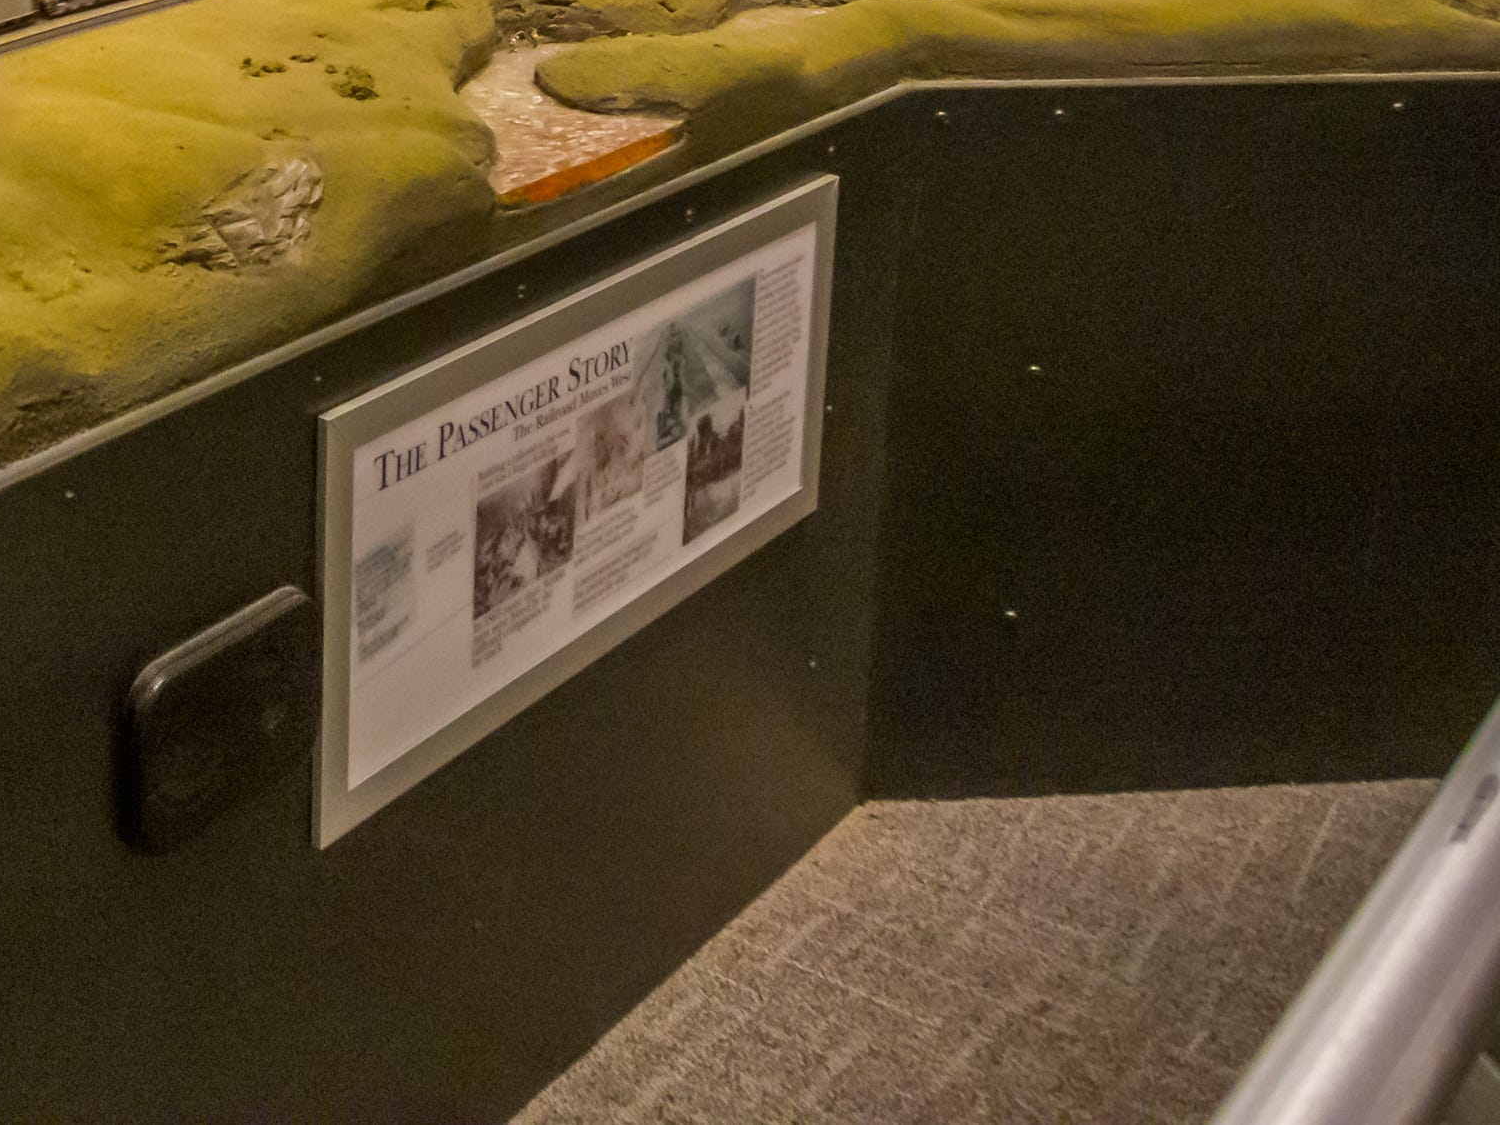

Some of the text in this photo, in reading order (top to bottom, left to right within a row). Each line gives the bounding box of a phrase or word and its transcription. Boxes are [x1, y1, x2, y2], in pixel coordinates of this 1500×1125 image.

[374, 443, 428, 491] THE
[437, 375, 561, 461] PASSENGER
[567, 340, 632, 392] STORY
[512, 423, 532, 442] The
[536, 396, 577, 429] Railroad
[579, 383, 607, 407] Moves
